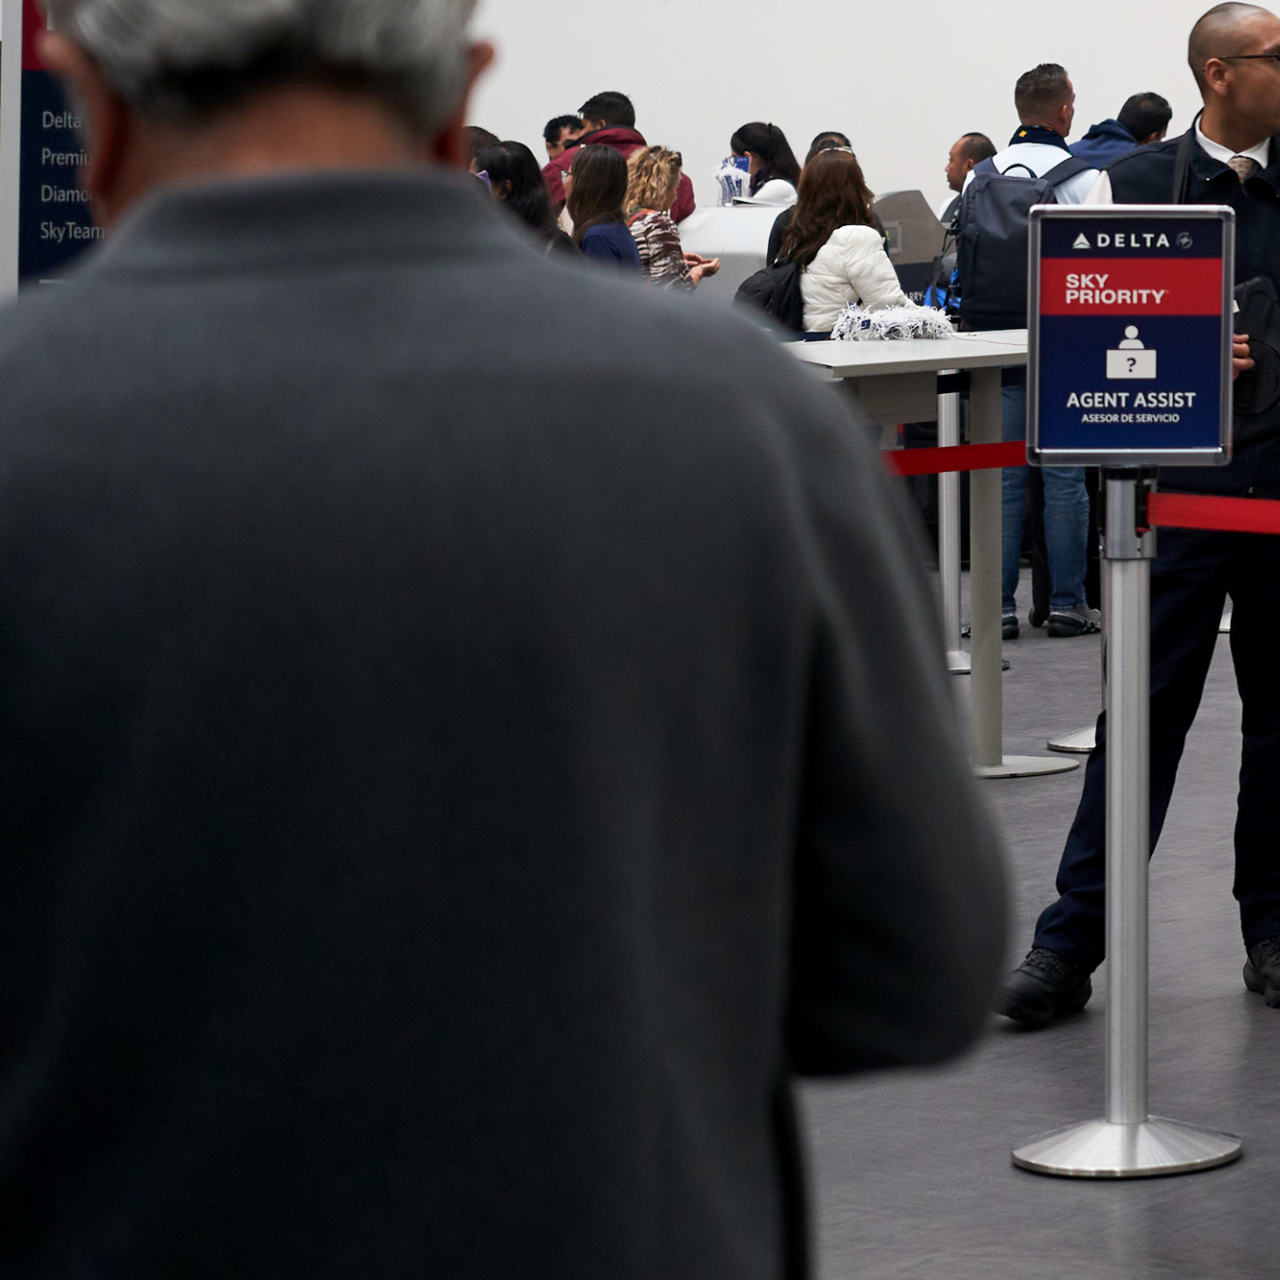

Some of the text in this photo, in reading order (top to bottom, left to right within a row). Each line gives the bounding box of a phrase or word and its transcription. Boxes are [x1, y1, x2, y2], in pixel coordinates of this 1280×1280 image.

[42, 111, 83, 129] Delta
[1097, 233, 1170, 248] DELTA
[1065, 273, 1109, 288] SKY
[1065, 289, 1165, 304] PRIORITY
[1066, 392, 1196, 408] AGENT ASSIST
[1081, 413, 1180, 423] ASESOR DE SERVICIO
